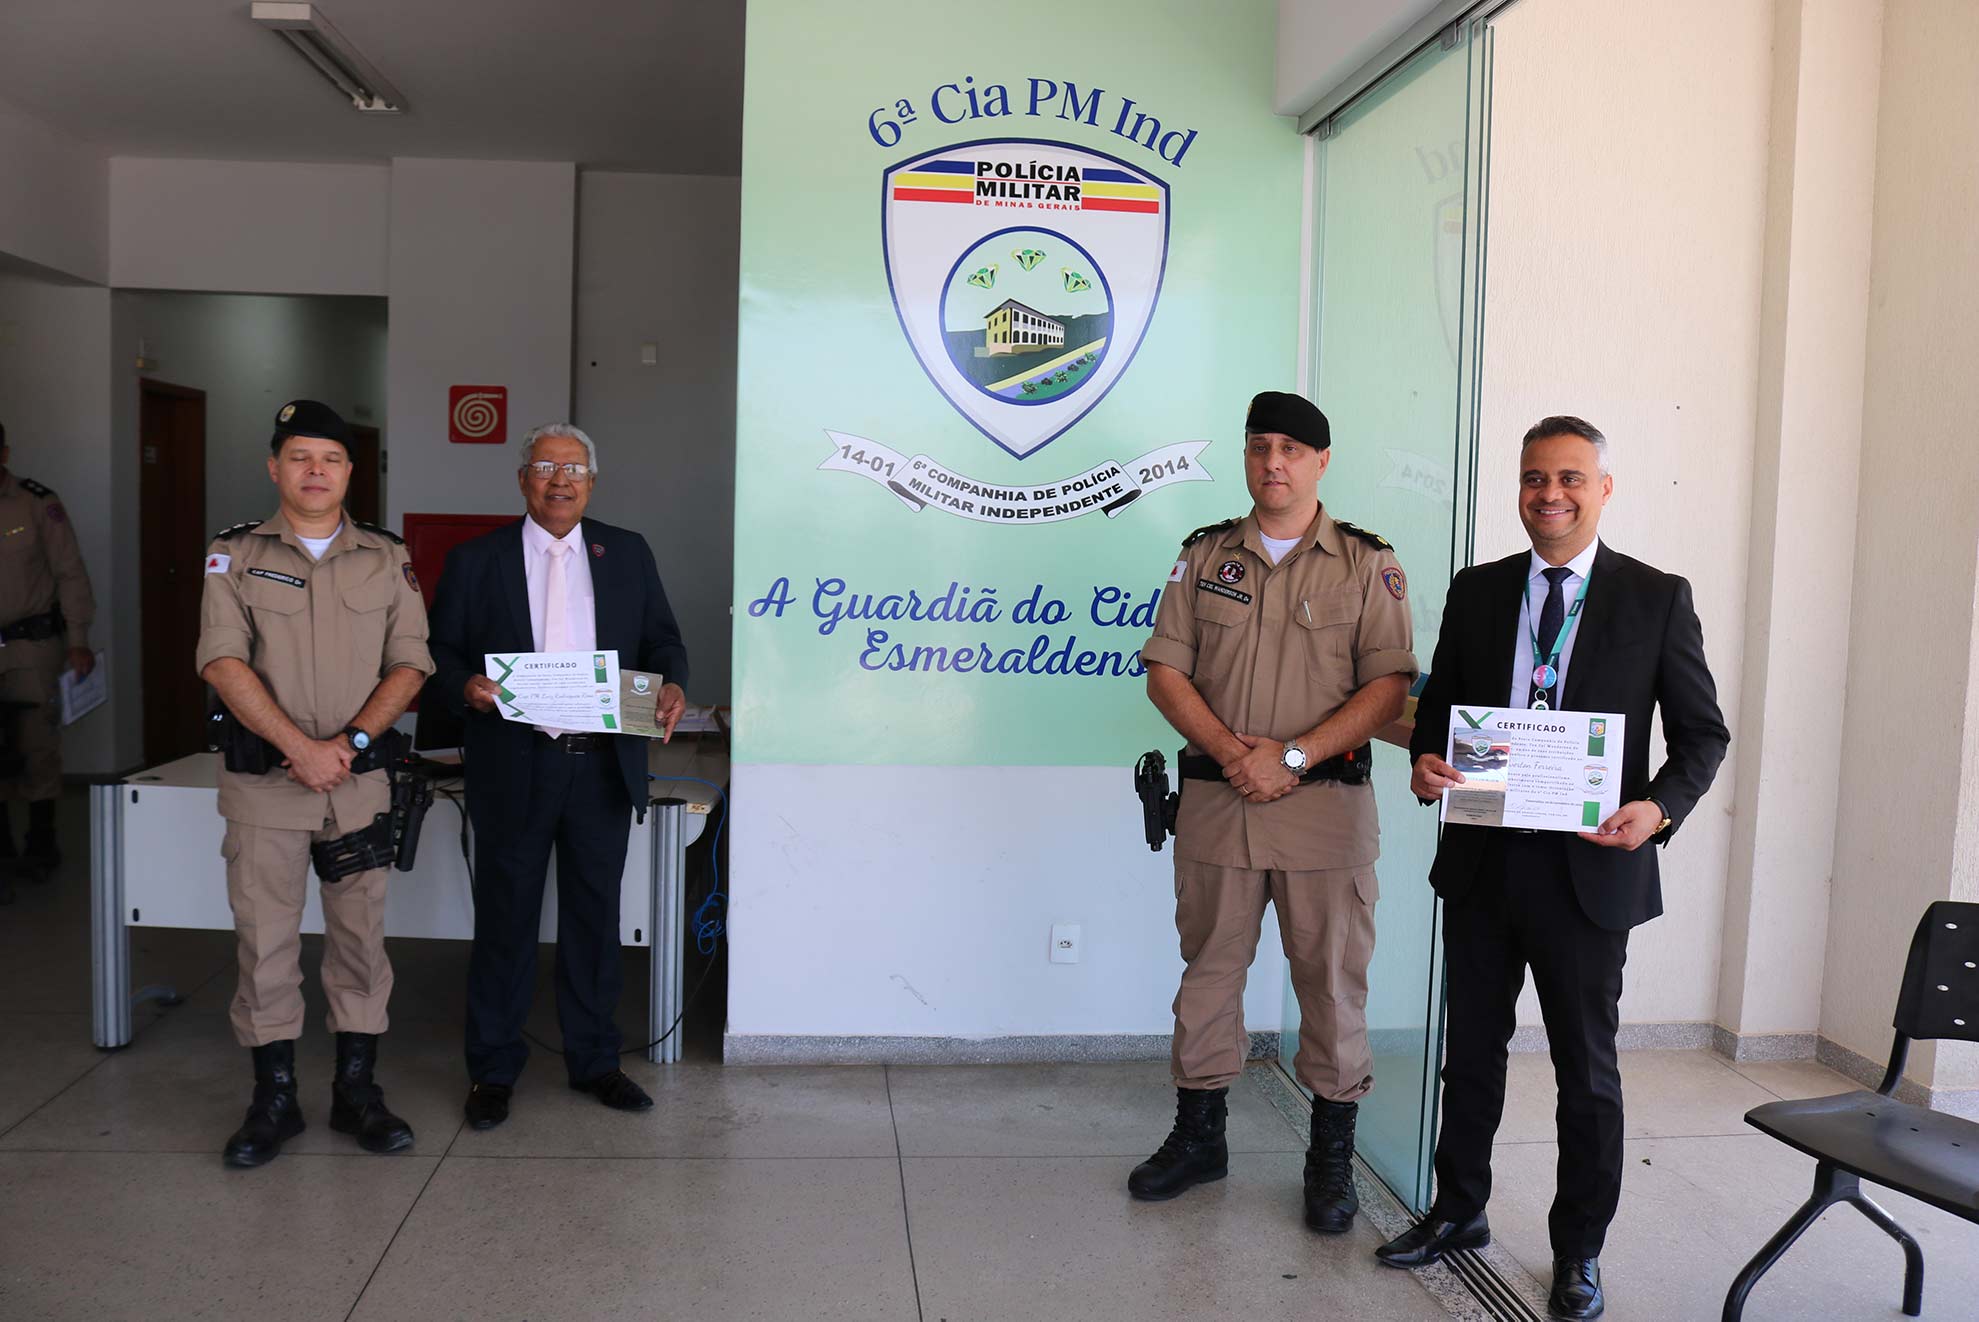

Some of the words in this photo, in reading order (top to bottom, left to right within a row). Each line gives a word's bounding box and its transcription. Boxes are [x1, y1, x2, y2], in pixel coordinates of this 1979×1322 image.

[868, 97, 917, 148] 6ª
[931, 75, 1013, 125] Cia
[1025, 78, 1105, 127] PM
[1110, 97, 1198, 168] Ind
[976, 160, 1081, 182] POLÍCIA
[975, 199, 992, 207] DE
[995, 200, 1034, 209] MINAS
[1038, 202, 1081, 211] GERAIS
[976, 180, 1081, 202] MILITAR
[840, 444, 896, 477] 14-01
[1138, 455, 1190, 485] 2014
[912, 459, 928, 472] 6ª
[928, 467, 1027, 502] COMPANHIA
[1032, 490, 1057, 502] DE
[1061, 465, 1121, 497] POLÍCIA
[908, 477, 974, 513] MILITAR
[980, 483, 1124, 519] INDEPENDENTE
[748, 577, 797, 618] A
[811, 577, 1002, 636] Guardiã
[1011, 584, 1072, 625] do
[1090, 585, 1161, 628] Cid
[524, 662, 577, 670] CERTIFICADO
[858, 627, 1148, 677] Esmeraldens
[1497, 721, 1566, 733] CERTIFICADO
